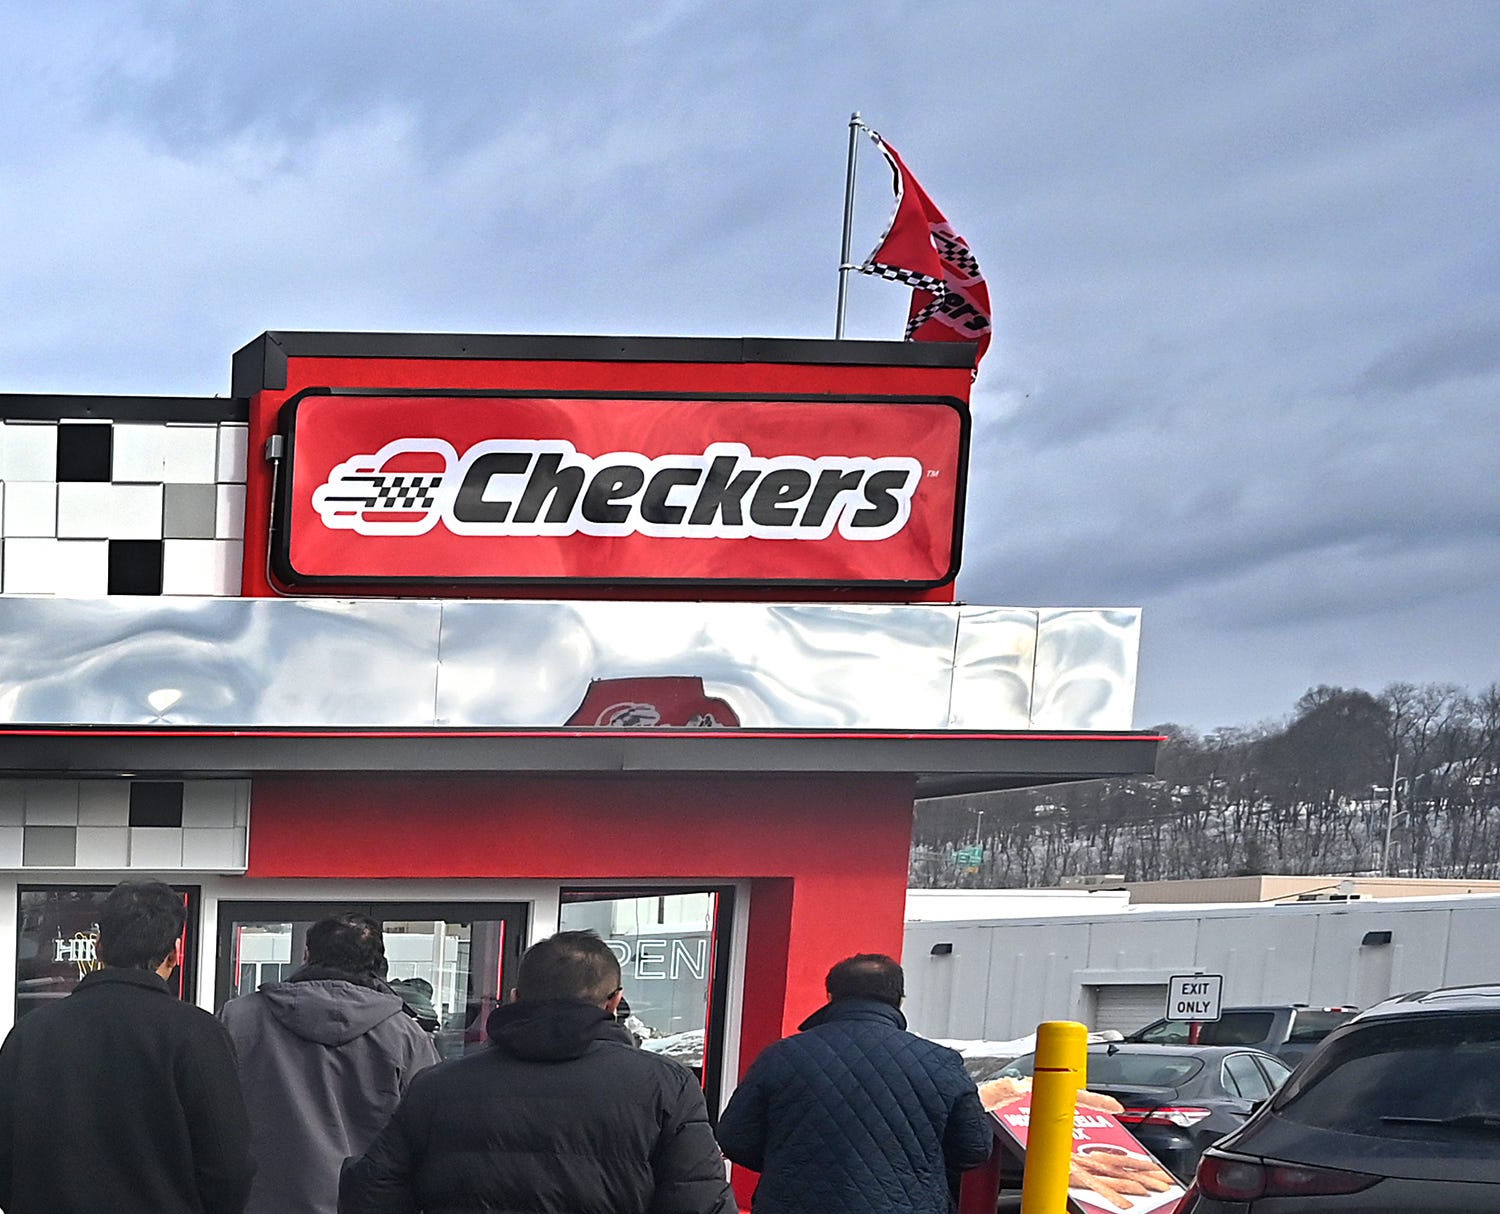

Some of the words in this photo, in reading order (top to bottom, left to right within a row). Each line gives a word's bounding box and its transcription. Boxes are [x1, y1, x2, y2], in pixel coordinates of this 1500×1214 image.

[453, 452, 910, 528] Checkers
[604, 939, 706, 979] PEN
[1182, 983, 1210, 995] EXIT
[1177, 1001, 1211, 1013] ONLY
